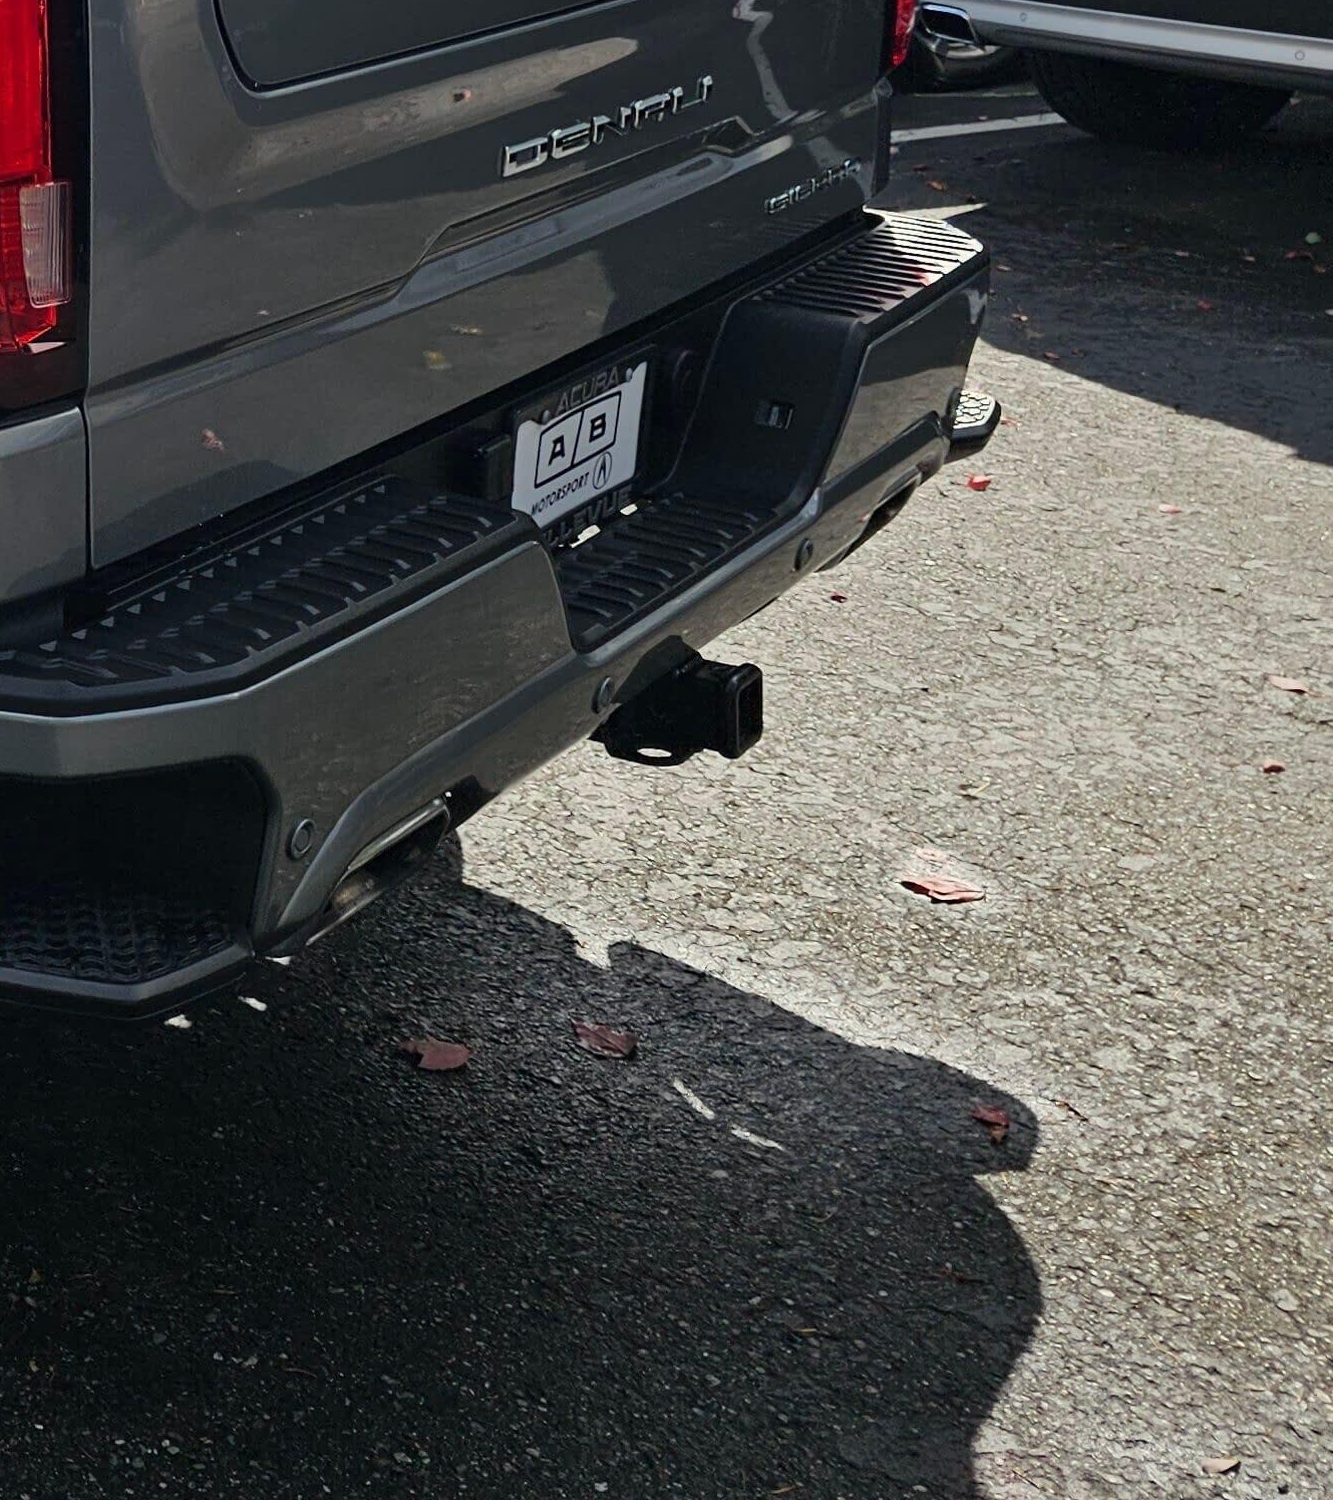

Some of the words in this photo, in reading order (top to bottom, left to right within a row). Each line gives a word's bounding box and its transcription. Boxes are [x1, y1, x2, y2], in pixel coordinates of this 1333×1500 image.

[501, 75, 714, 179] DENALI
[556, 366, 620, 414] ACURA
[548, 434, 566, 467] A
[588, 412, 607, 444] B
[531, 471, 590, 517] MOTORSPORT
